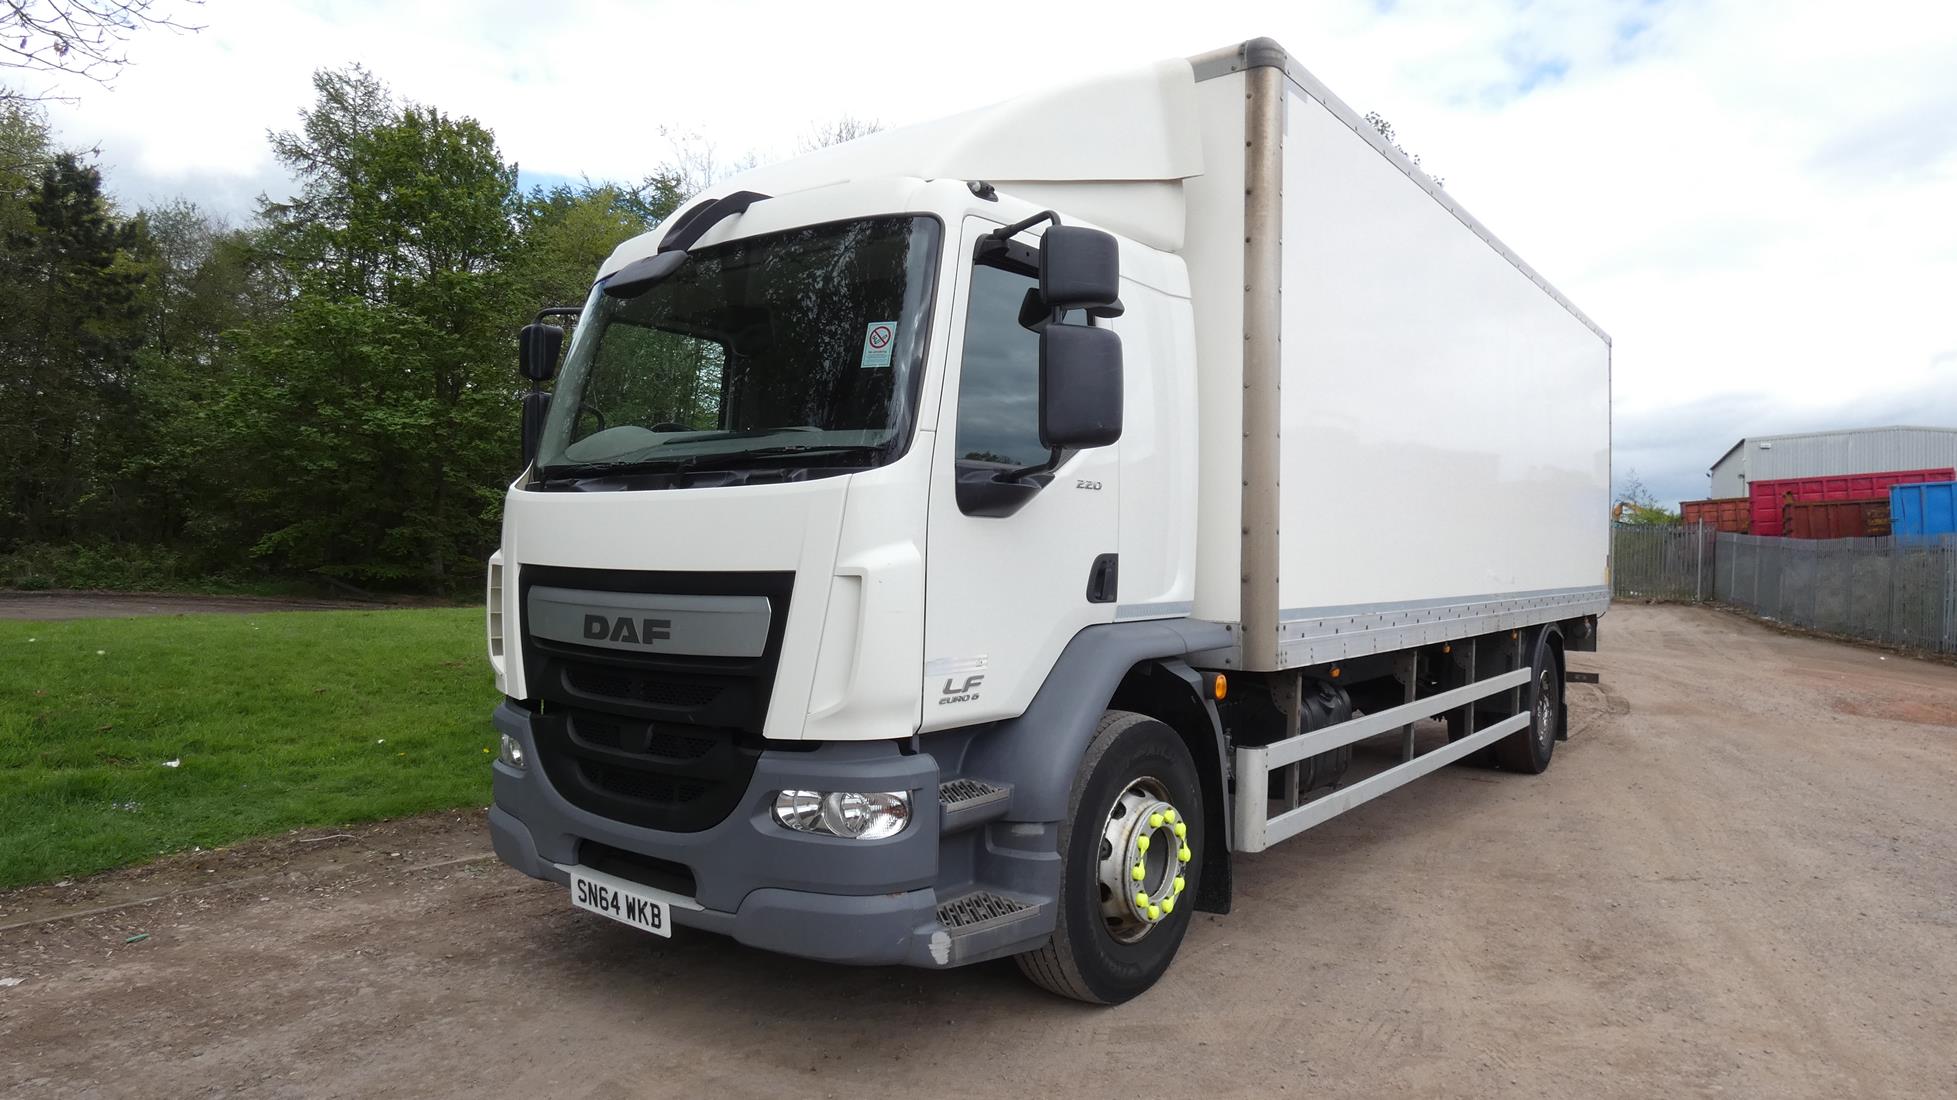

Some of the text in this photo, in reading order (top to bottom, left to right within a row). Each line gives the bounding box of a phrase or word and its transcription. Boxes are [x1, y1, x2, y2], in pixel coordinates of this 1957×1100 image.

[1076, 479, 1103, 491] 220
[584, 614, 671, 644] DAF
[942, 675, 985, 695] LF
[938, 693, 980, 705] EURO 6
[577, 879, 662, 929] SN64 WKB
